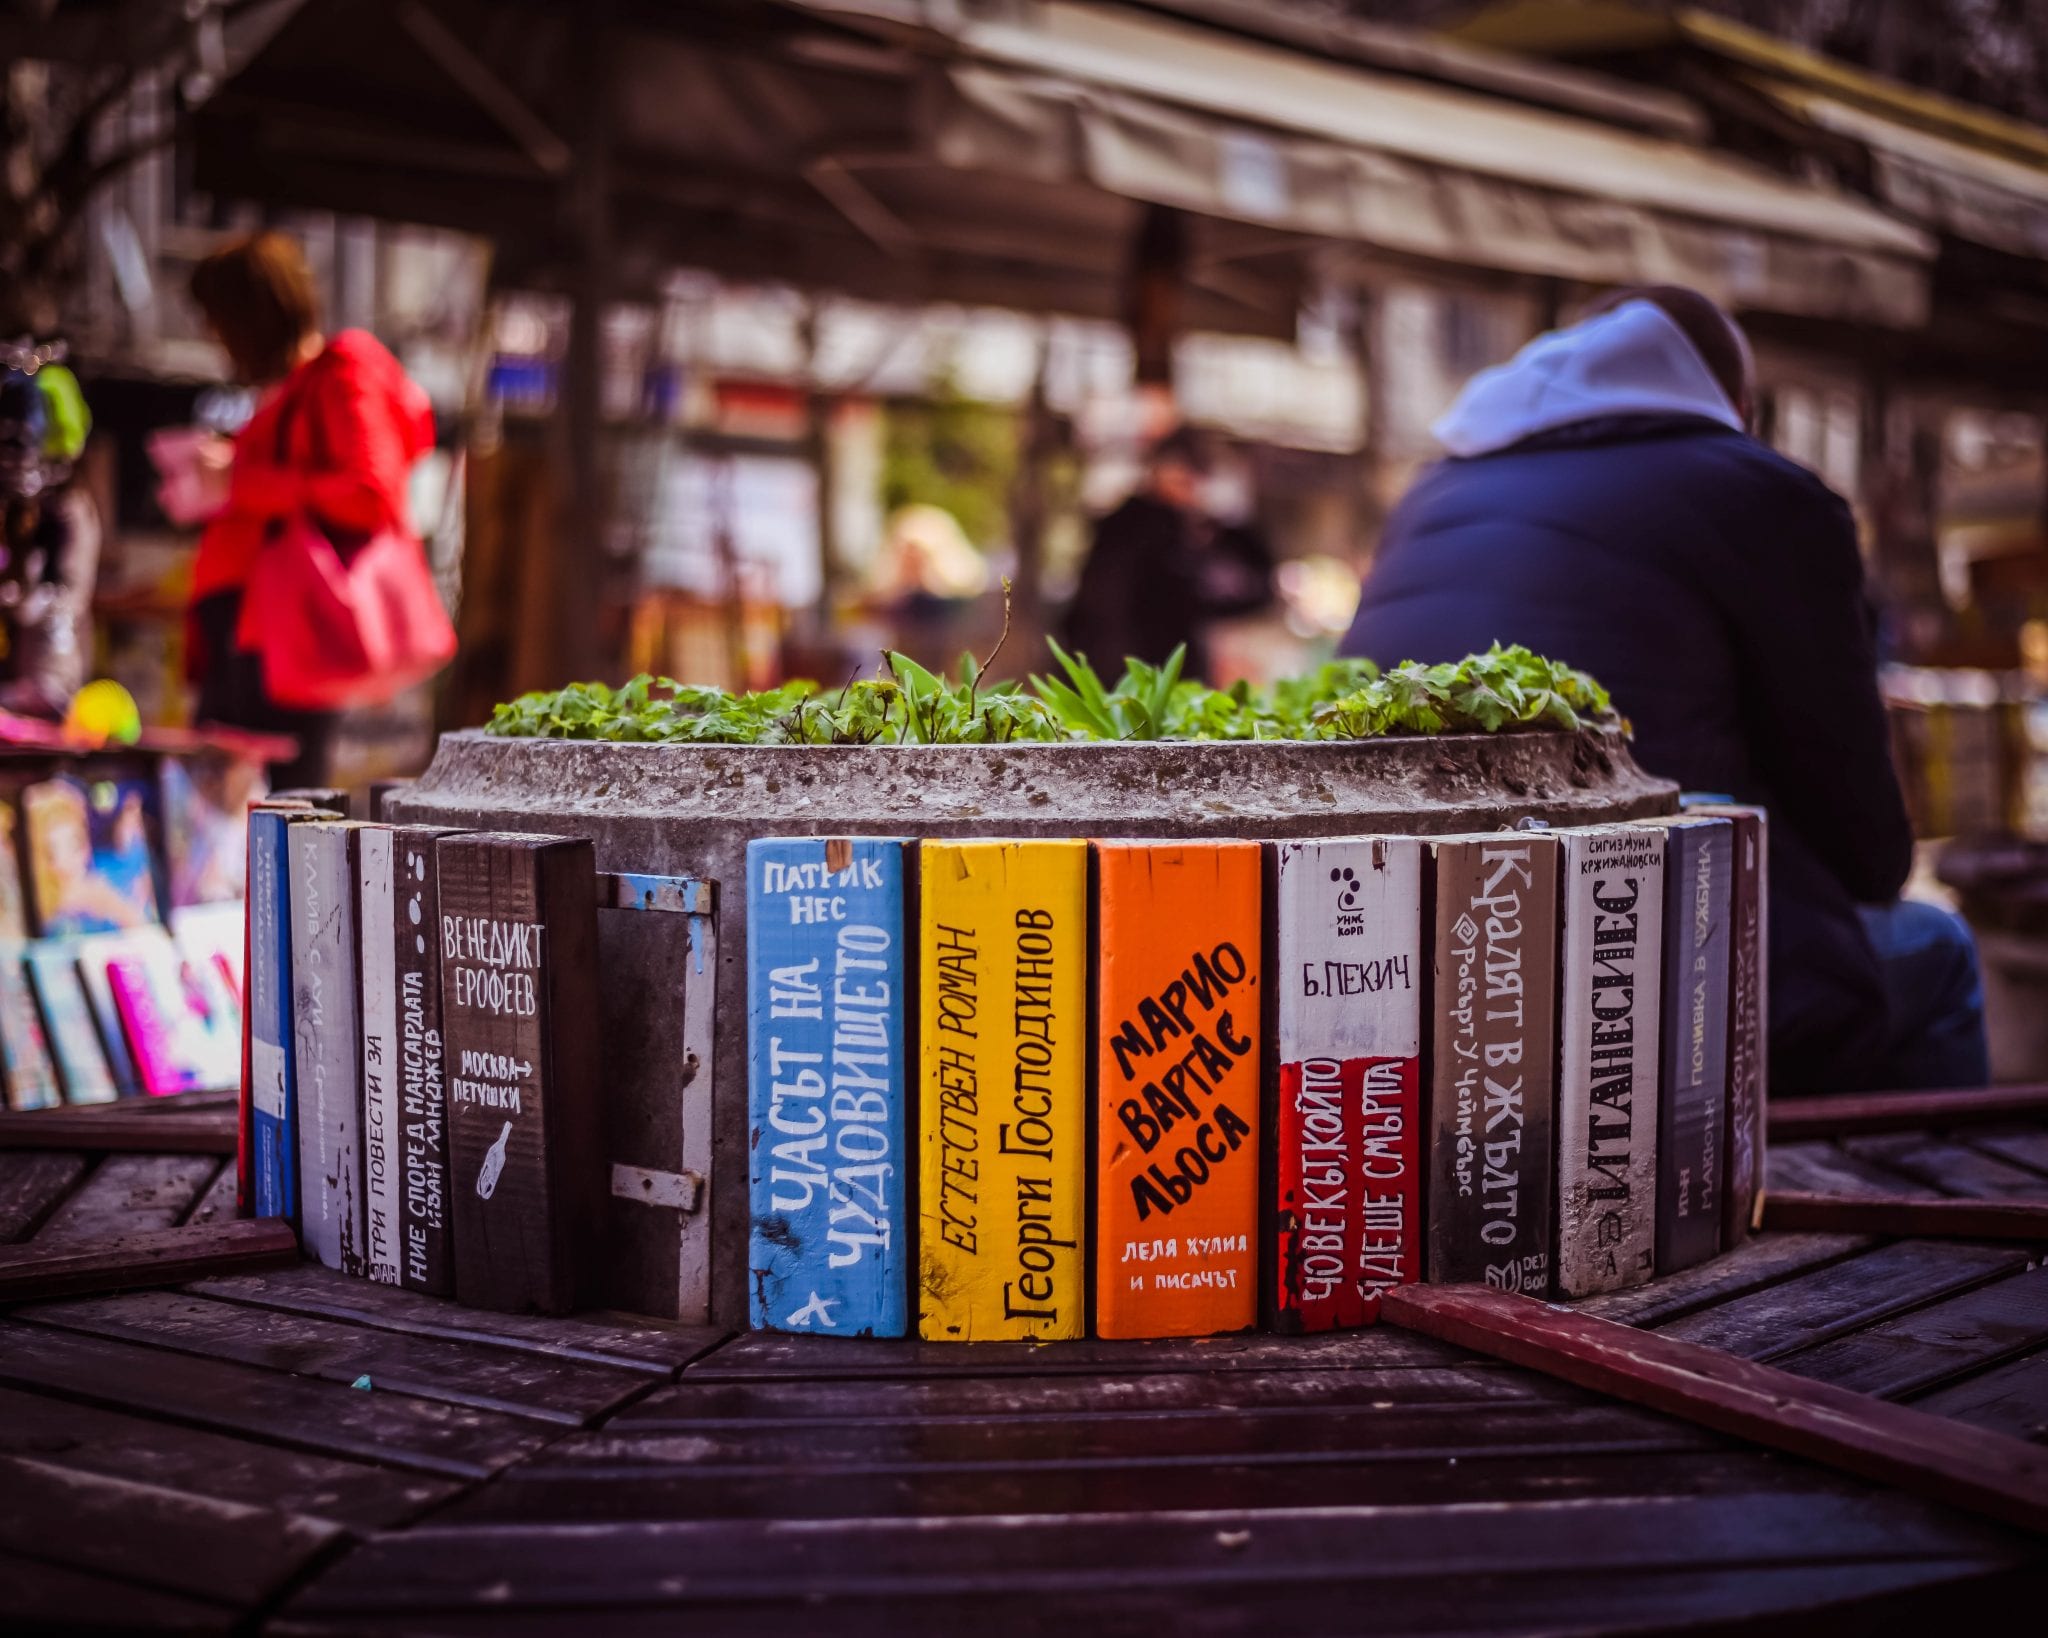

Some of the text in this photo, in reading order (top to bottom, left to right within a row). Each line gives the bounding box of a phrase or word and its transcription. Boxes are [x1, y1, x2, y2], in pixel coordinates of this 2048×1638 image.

[443, 915, 545, 970] ВЕНЕДИКТ
[789, 895, 847, 925] НЕС
[1337, 925, 1364, 938] КОРП
[1470, 846, 1533, 1028] Кралят
[1694, 840, 1712, 947] ЧУЖБИНА
[456, 966, 536, 1016] ЕРОФЕЕВ
[1110, 941, 1247, 1081] МАРИО
[1588, 877, 1640, 1201] ИТАНЕСИЕС
[1690, 980, 1707, 1087] ПОЧИВКА
[367, 1034, 383, 1065] ЗА
[453, 1078, 521, 1114] ПЕТУШКИ
[462, 1050, 518, 1081] МОСКВА
[769, 957, 828, 1213] ЧАСЪТ НА
[827, 924, 894, 1268] ЧУДОВИЩЕТО
[936, 924, 979, 1256] ЕСТЕСТВЕН РОМАН
[1116, 1009, 1252, 1155] ВАРГАС
[368, 1073, 385, 1197] ПОВЕСТИ
[403, 972, 427, 1282] НИЕ СПОРЕД МАНСАРДАТА
[424, 1028, 443, 1228] ИВАН ЛАНДЖЕВ
[1129, 1103, 1251, 1222] ЛЬОСА
[370, 1207, 387, 1259] ТРИ
[1003, 1178, 1077, 1324] Георги
[1121, 1234, 1248, 1264] ЛЕЛЯ ХУЛИЯ
[1356, 1190, 1405, 1302] ЯДЕШЕ
